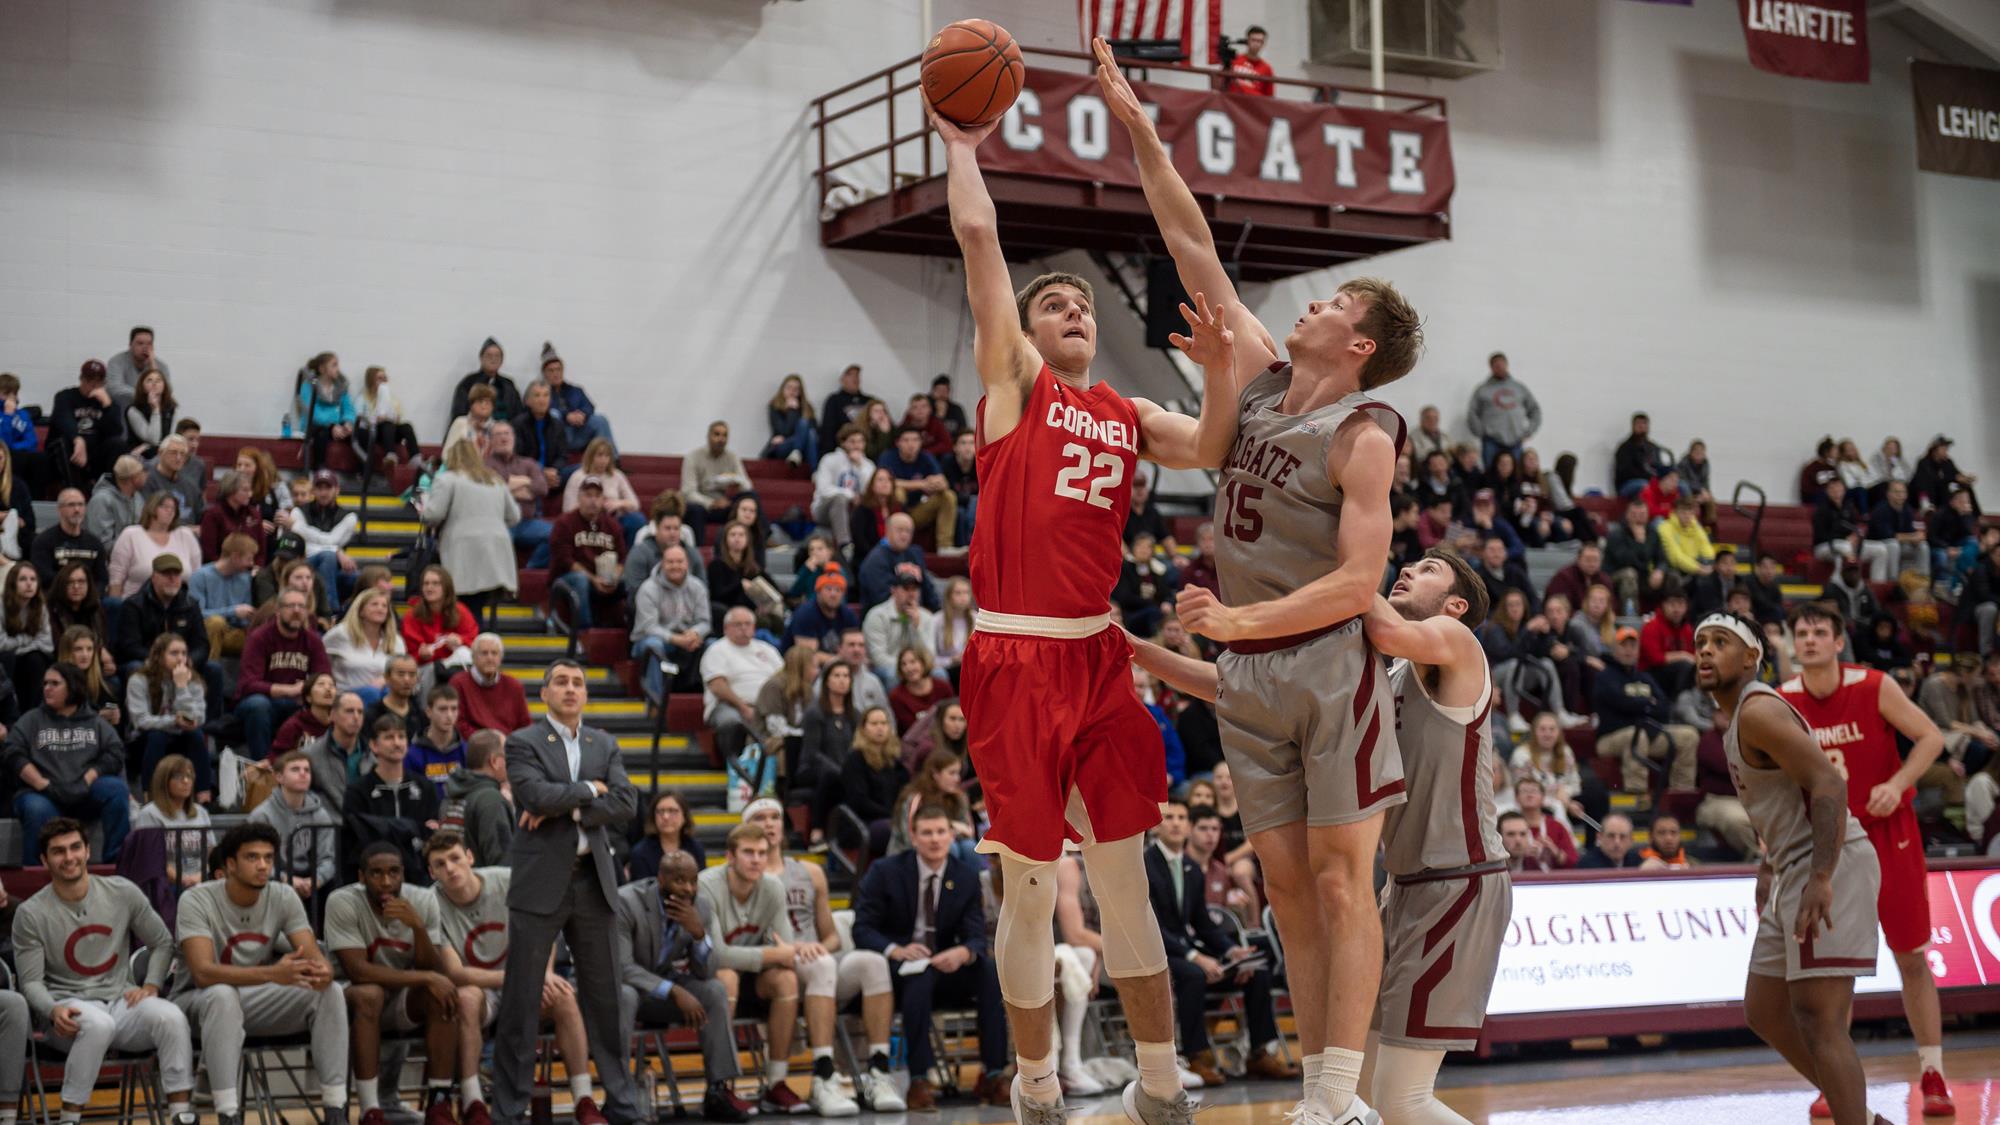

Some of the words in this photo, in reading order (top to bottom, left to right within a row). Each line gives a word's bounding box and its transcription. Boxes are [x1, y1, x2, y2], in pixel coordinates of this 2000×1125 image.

[1748, 0, 1857, 45] LAFAYETTE
[1003, 88, 1427, 194] COGATE
[1937, 104, 2000, 142] LEHIG
[1054, 442, 1125, 511] 22
[1229, 433, 1303, 490] LGATE
[1223, 480, 1264, 543] 15
[1815, 720, 1864, 747] RNELL
[1503, 911, 1646, 948] OLGATE
[1656, 906, 1760, 940] UNIV
[1502, 964, 1544, 984] ning
[1550, 959, 1633, 981] Services
